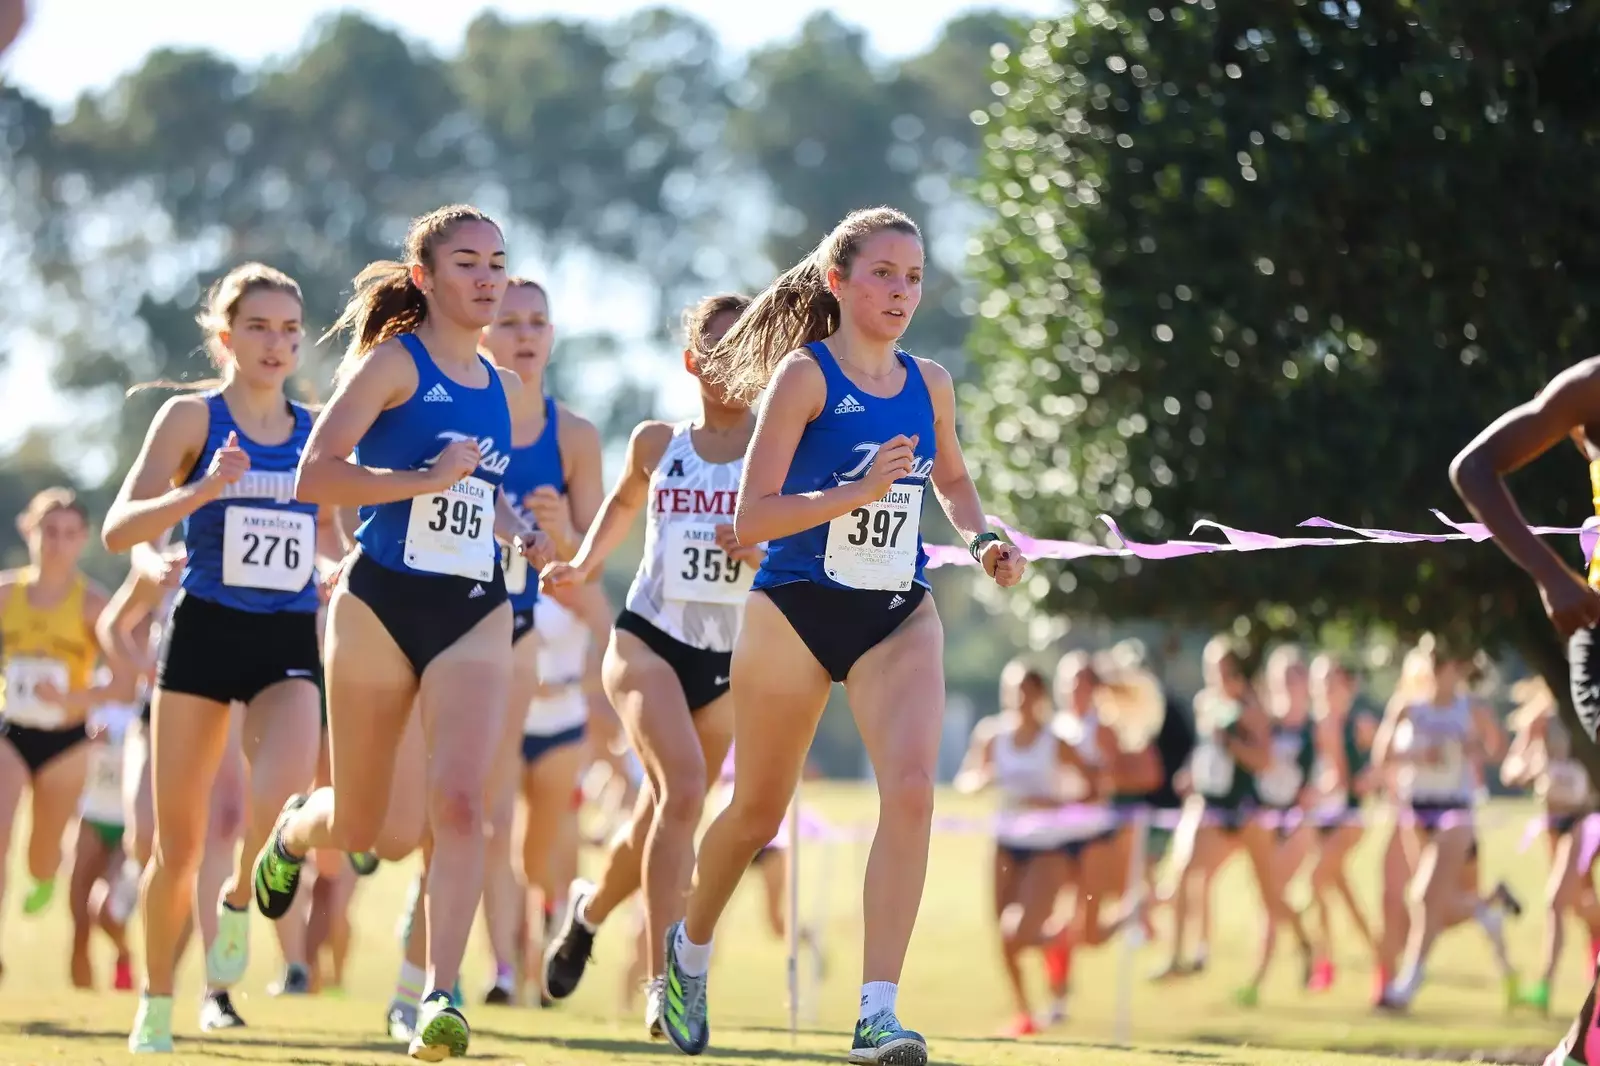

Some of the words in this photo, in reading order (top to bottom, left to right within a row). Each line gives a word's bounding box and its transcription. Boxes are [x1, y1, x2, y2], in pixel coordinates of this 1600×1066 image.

[834, 405, 866, 415] adidas
[419, 430, 510, 475] Tlsa
[667, 459, 685, 477] A
[840, 441, 934, 482] Tsa
[448, 481, 485, 498] ERICAN
[880, 492, 911, 504] RICAN
[243, 517, 302, 530] AMERICAN
[428, 496, 483, 539] 395
[847, 507, 908, 548] 397
[242, 533, 301, 569] 276
[681, 547, 742, 583] 359
